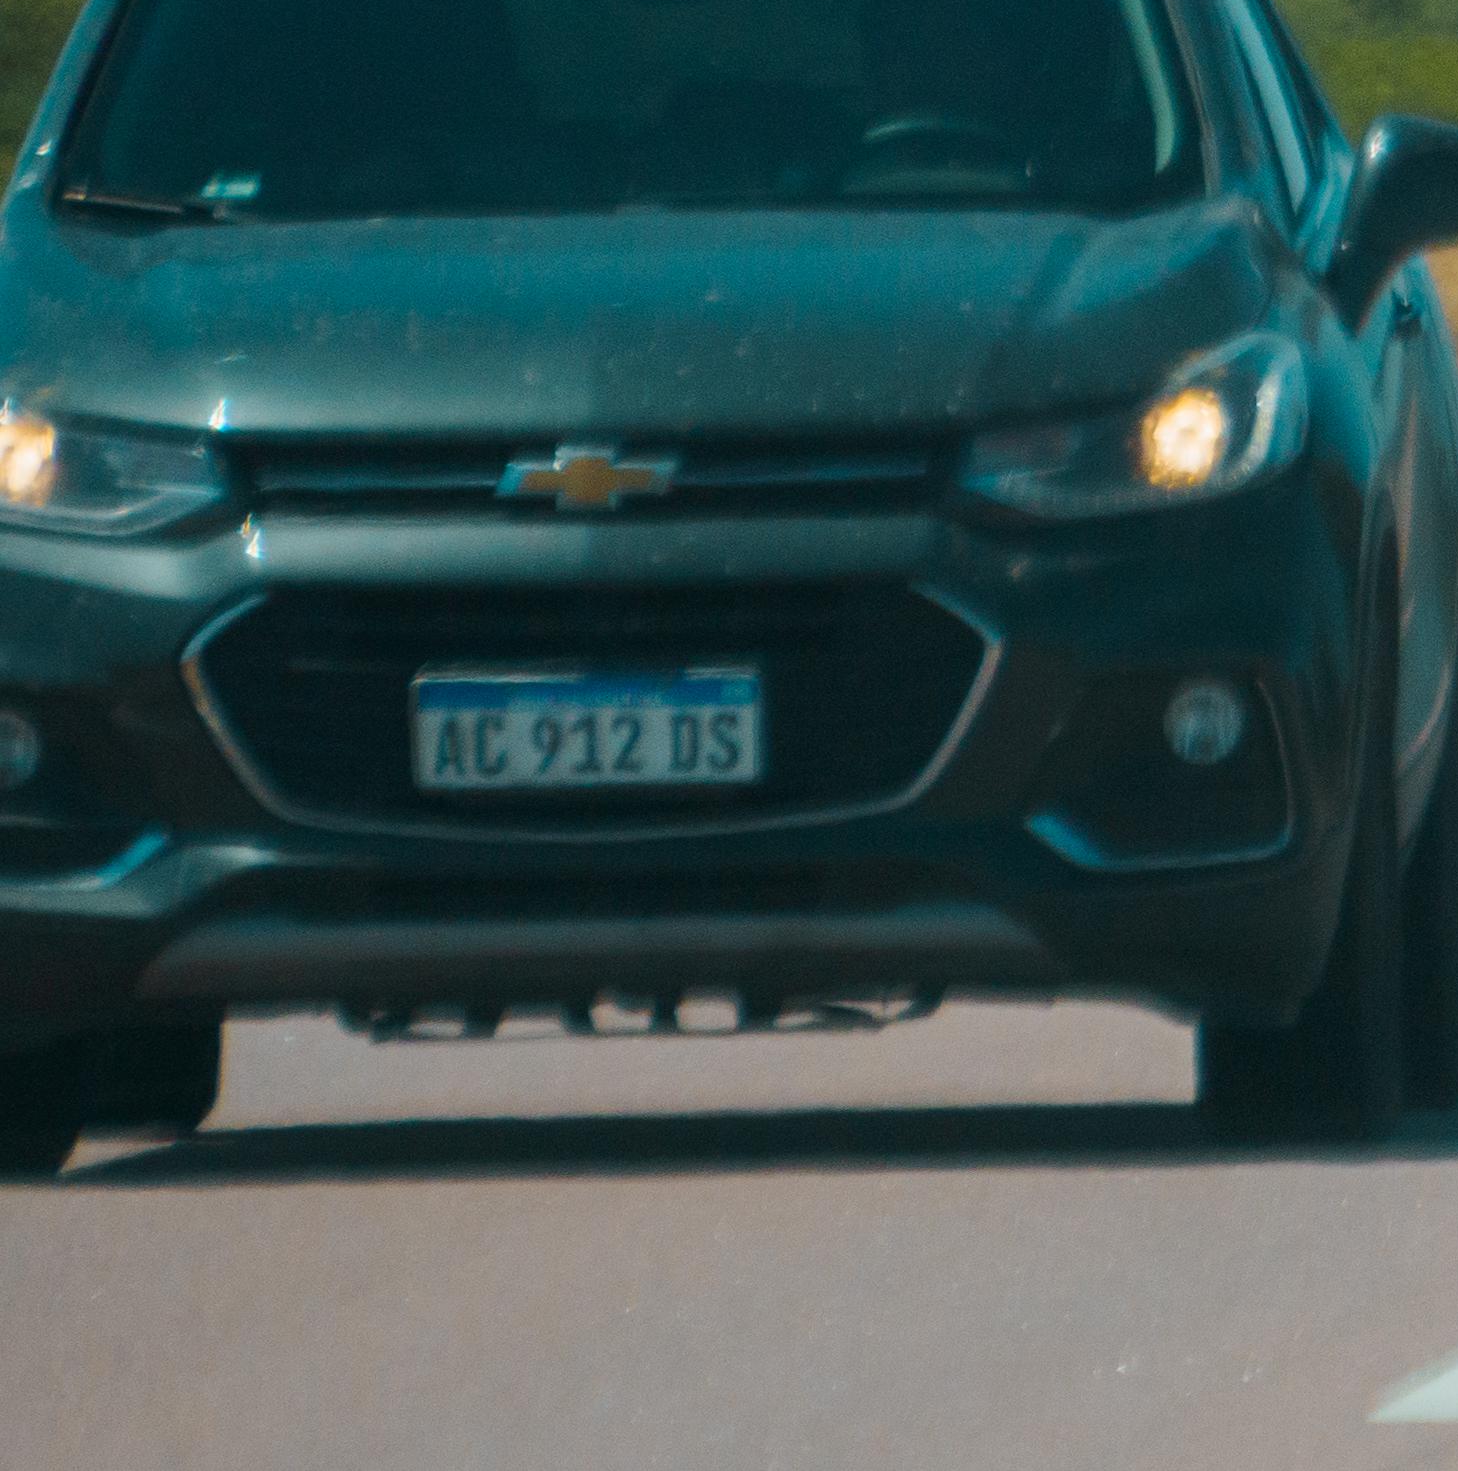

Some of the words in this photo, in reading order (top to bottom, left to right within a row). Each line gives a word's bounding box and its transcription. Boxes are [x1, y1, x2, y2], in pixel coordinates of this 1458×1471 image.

[433, 714, 508, 776] AC
[532, 713, 644, 774] 912
[670, 713, 740, 774] DS
